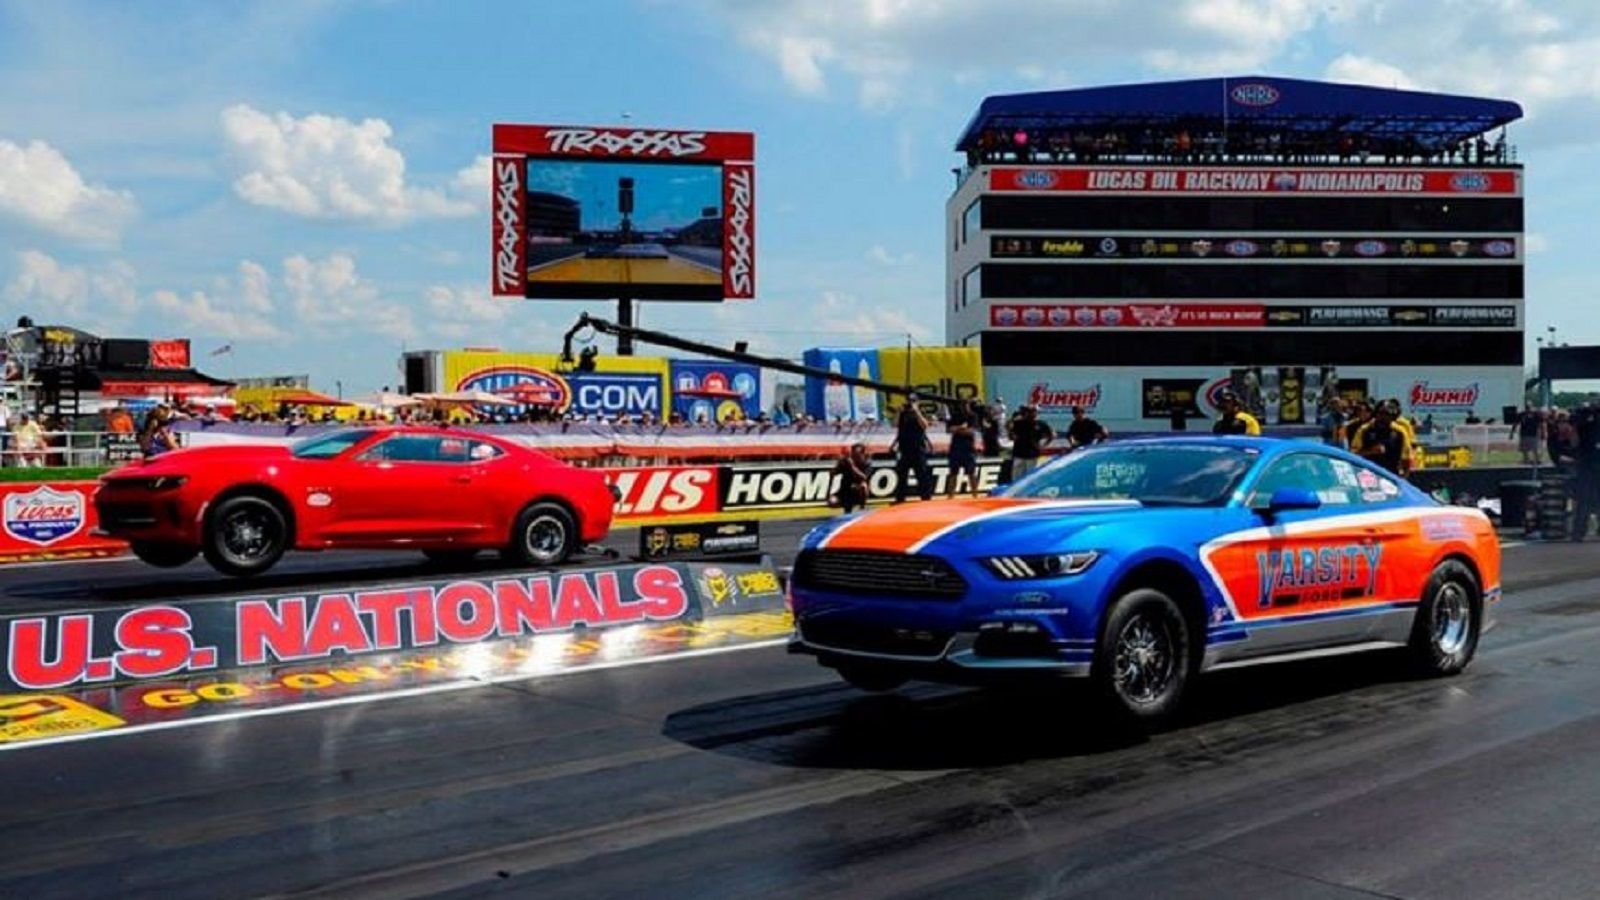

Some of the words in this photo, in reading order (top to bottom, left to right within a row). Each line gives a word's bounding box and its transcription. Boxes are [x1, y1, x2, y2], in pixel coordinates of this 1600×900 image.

[545, 129, 706, 155] TRAXXAS
[1087, 171, 1146, 189] LUCAS
[1152, 171, 1179, 189] OIL
[1184, 171, 1271, 190] RACEWAY
[1298, 172, 1424, 191] INDIANAPOLIS
[497, 161, 519, 291] TRAXXAS
[729, 169, 750, 294] TRAXXAS
[573, 384, 658, 410] .COM
[16, 505, 76, 519] LUCAS
[1256, 543, 1382, 608] VARSITY
[9, 606, 218, 689] U.S.
[236, 565, 688, 666] NATIONALS
